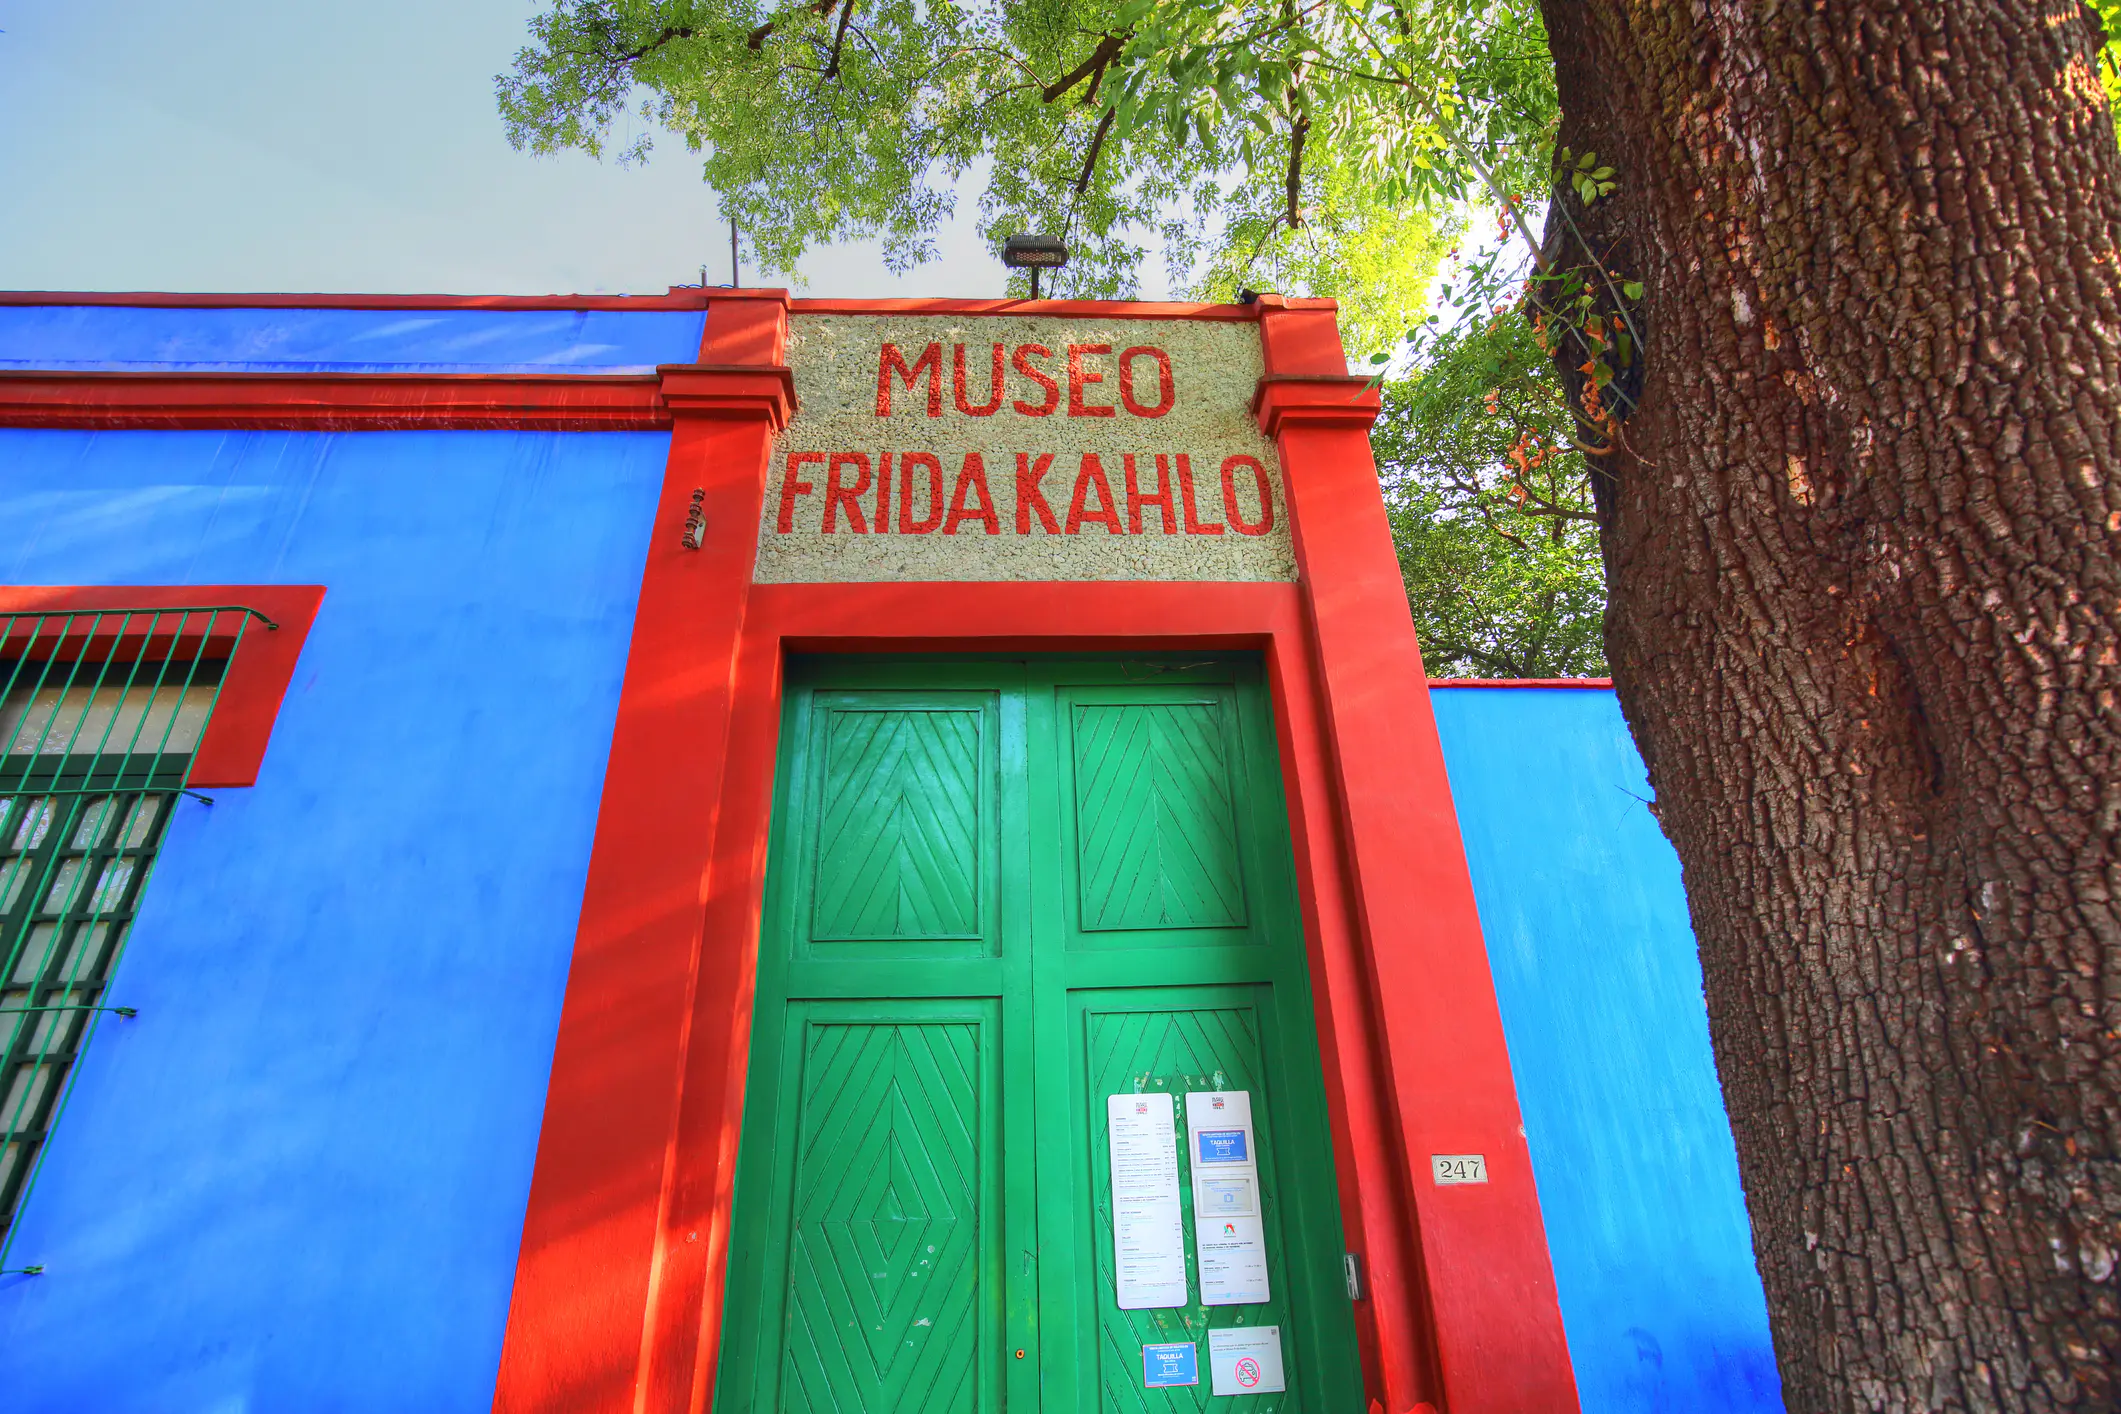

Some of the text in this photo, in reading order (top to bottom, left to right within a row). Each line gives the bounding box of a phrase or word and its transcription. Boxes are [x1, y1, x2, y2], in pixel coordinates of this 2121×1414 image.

[875, 342, 1175, 418] MUSEO
[777, 451, 1274, 537] FRIDA KAHLO
[1440, 1160, 1479, 1178] 247
